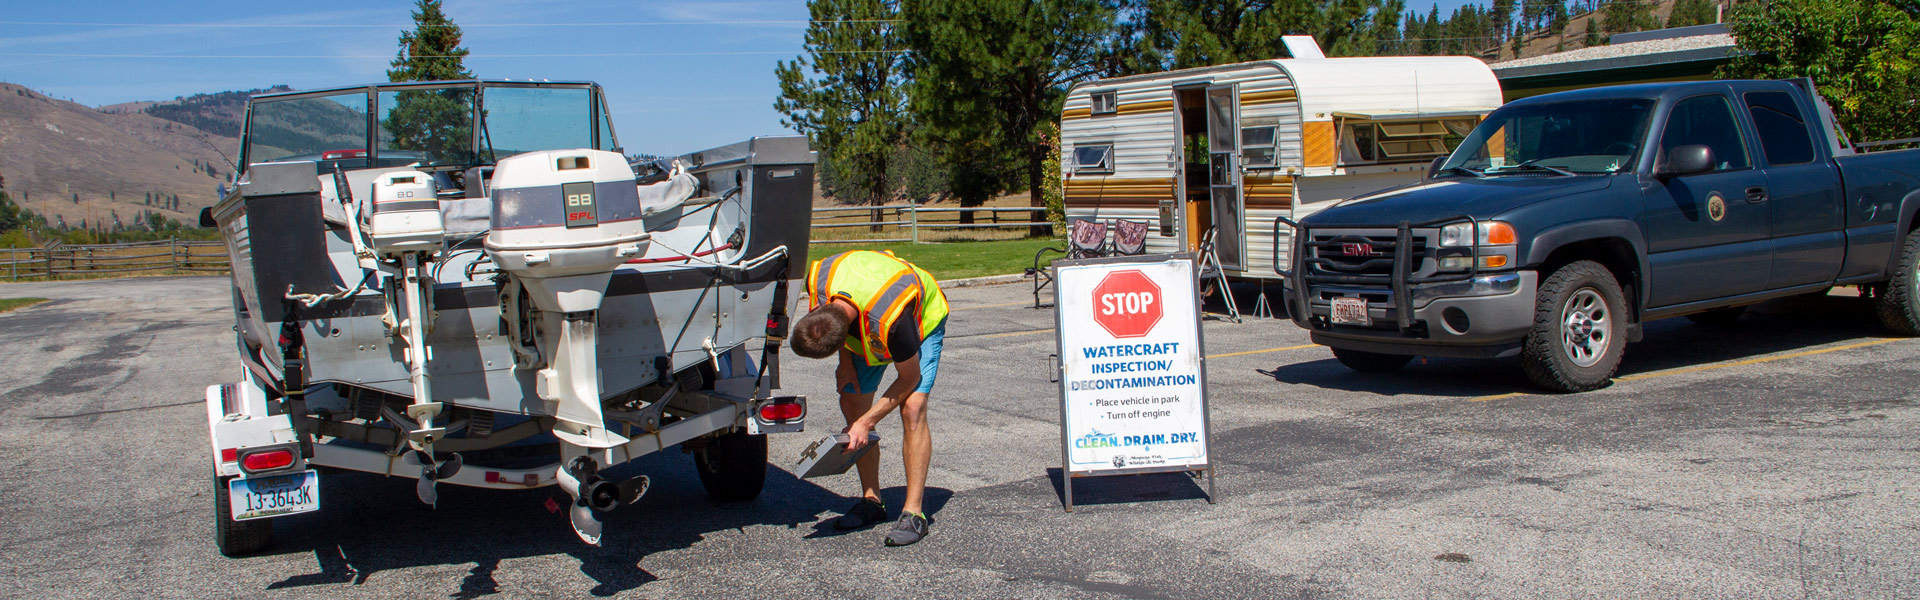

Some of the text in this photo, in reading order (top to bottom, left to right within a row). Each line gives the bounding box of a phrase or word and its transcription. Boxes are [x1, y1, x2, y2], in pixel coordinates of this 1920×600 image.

[568, 193, 592, 206] 88
[569, 211, 594, 221] SPL
[1101, 291, 1153, 316] STOP
[1083, 342, 1179, 359] WATERCRAFT
[1091, 359, 1173, 374] INSPECTION/
[1071, 374, 1195, 391] DECONTAMINATION
[1095, 394, 1180, 407] Place vehicle in park
[1107, 409, 1170, 420] Turn off engine
[1075, 432, 1198, 449] CLEAN. DRAIN. DRY.
